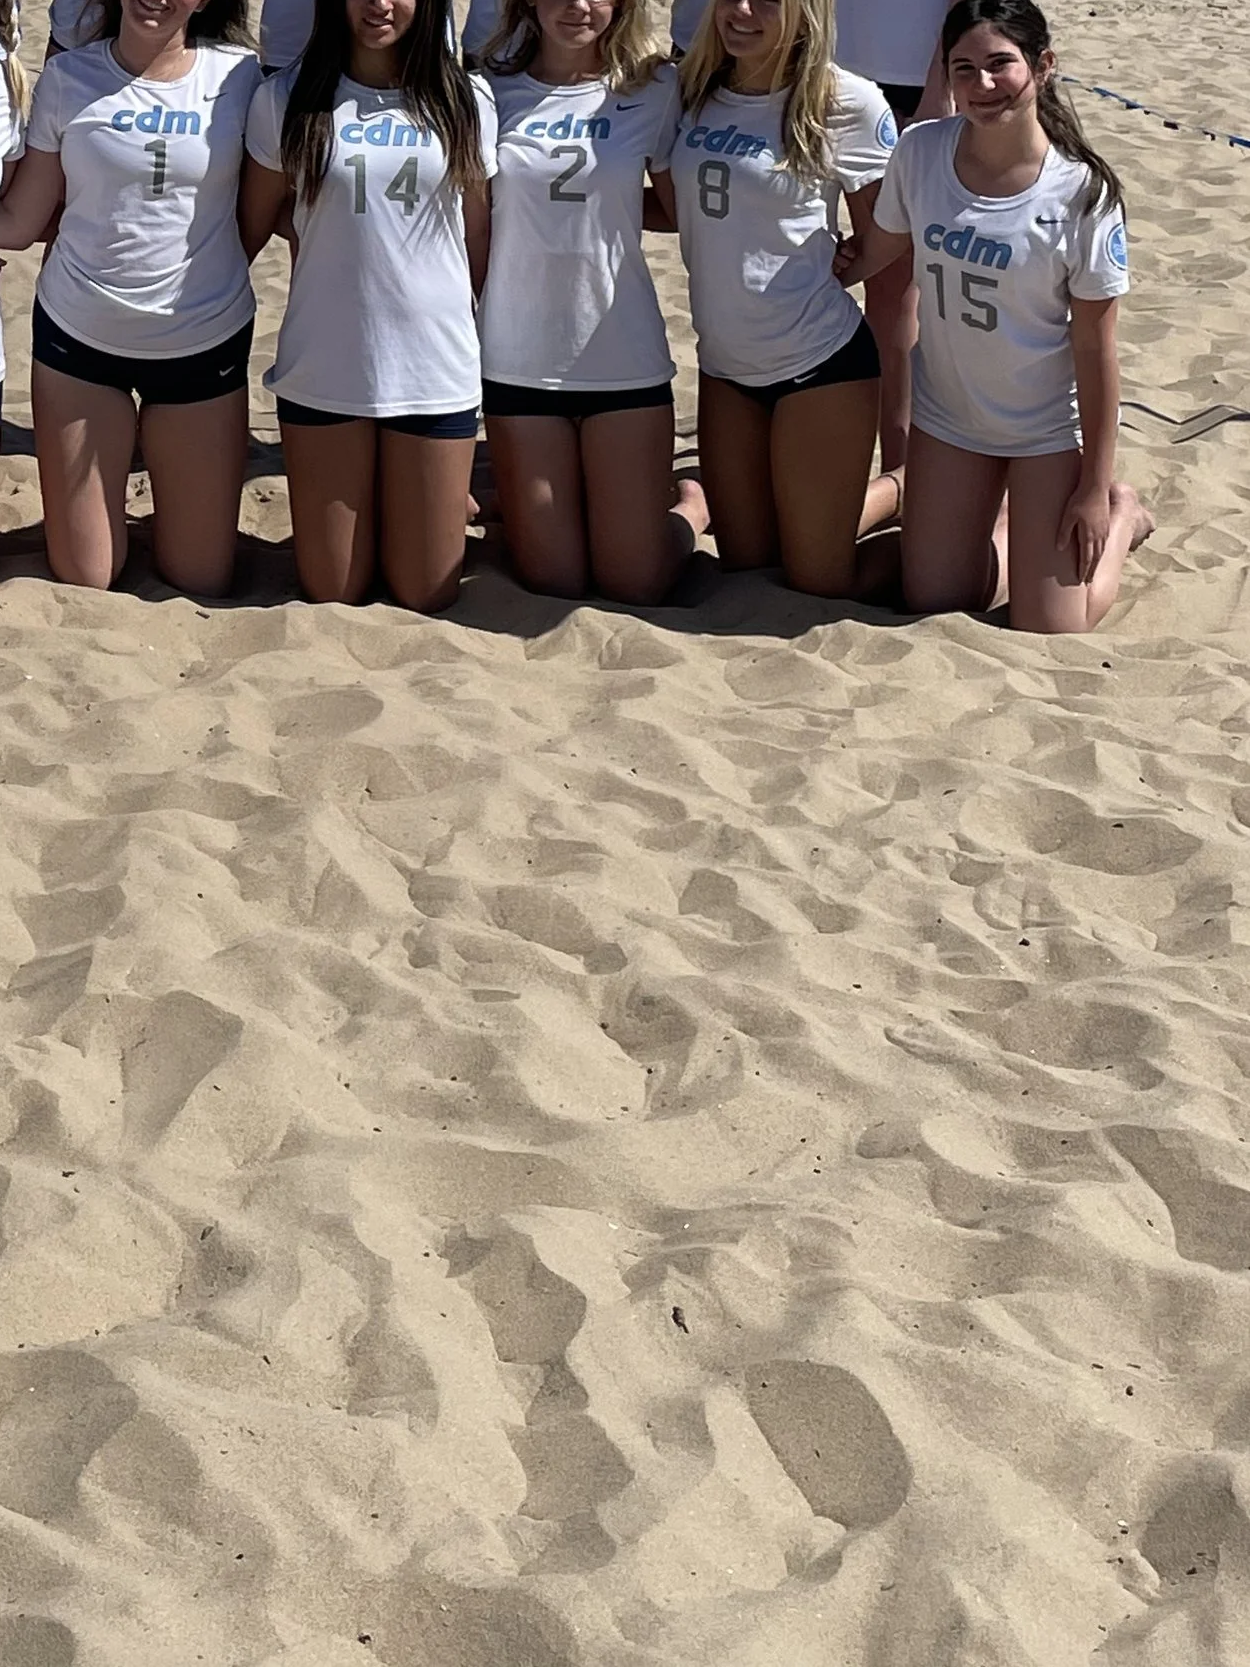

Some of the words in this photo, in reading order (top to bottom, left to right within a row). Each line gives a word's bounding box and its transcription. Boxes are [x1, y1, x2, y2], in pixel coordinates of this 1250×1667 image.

[111, 105, 200, 136] cdm
[340, 117, 432, 147] cdm
[524, 113, 611, 140] cdm
[686, 125, 766, 159] cdm
[143, 139, 167, 197] 1
[344, 153, 420, 216] 14
[550, 145, 587, 202] 2
[697, 160, 731, 220] 8
[924, 222, 1013, 270] cdm
[926, 263, 998, 332] 15
